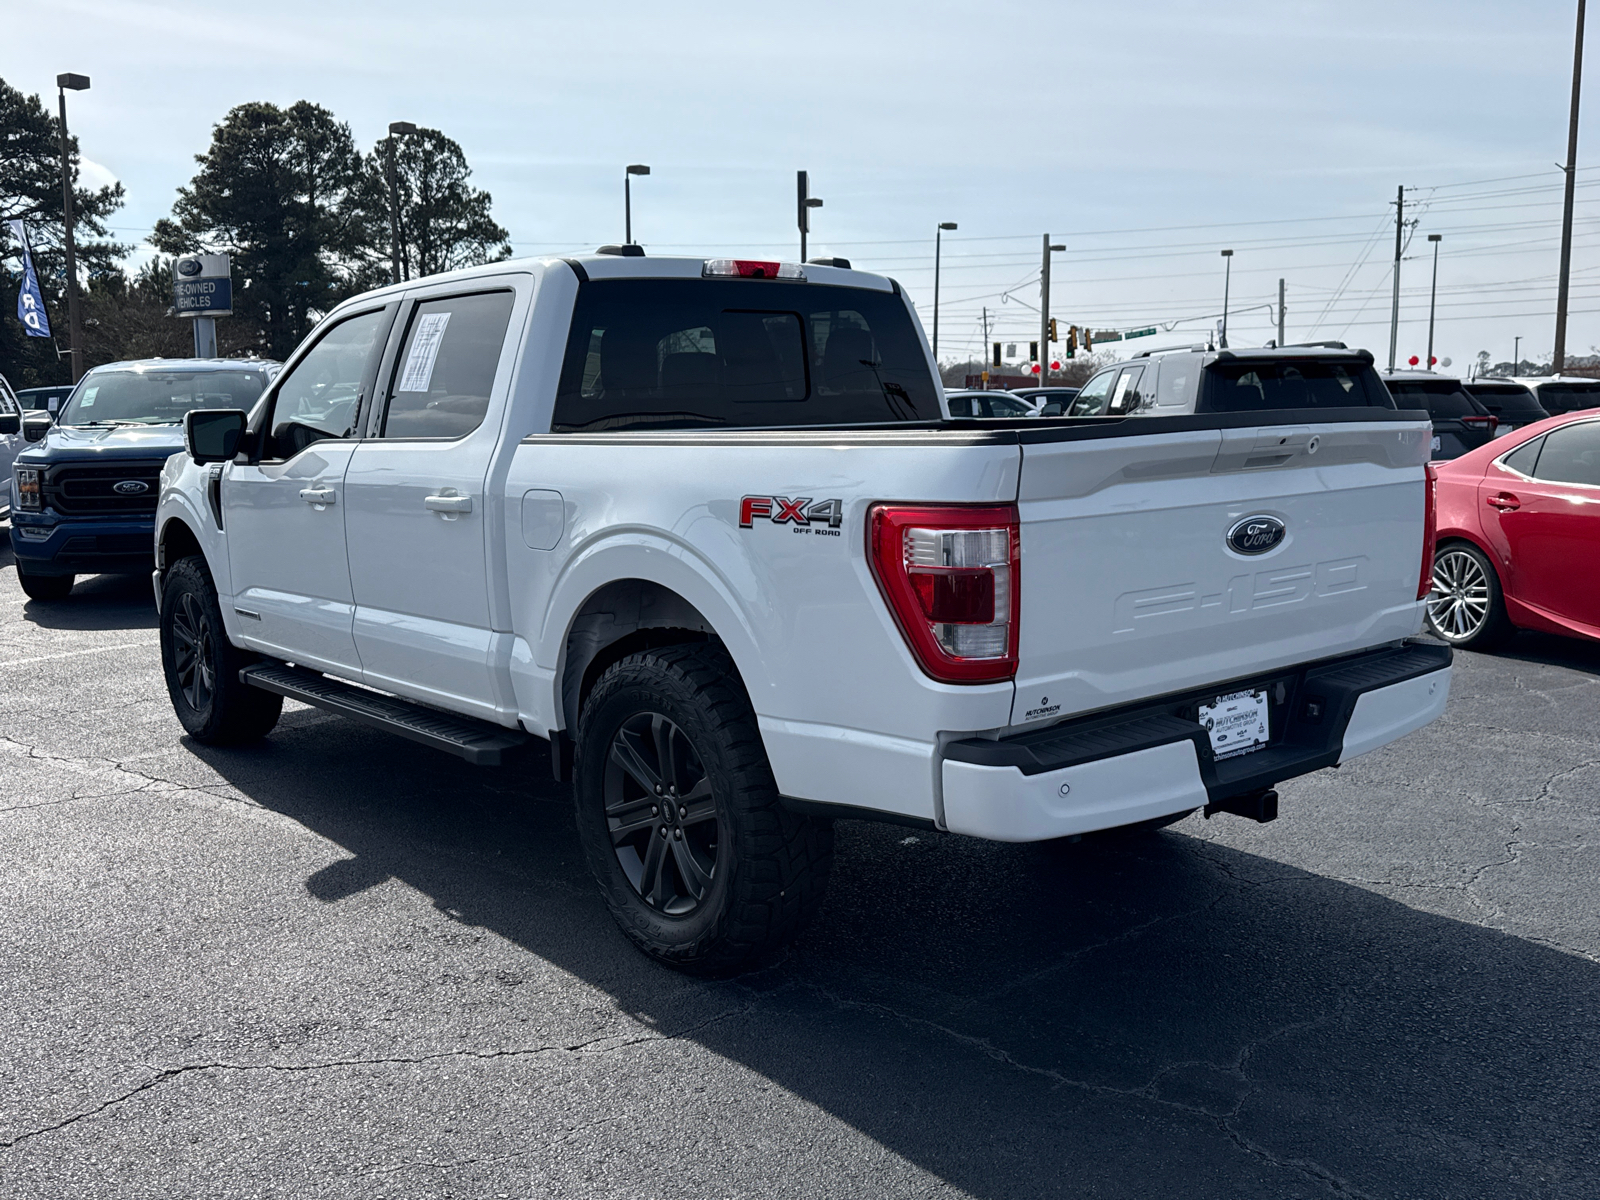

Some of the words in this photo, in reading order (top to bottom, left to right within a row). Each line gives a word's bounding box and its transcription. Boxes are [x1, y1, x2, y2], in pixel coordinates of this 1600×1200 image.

[176, 296, 211, 309] VEHICLES
[121, 482, 142, 492] Ford
[739, 494, 843, 530] FX4
[814, 529, 841, 537] ROAD
[1243, 523, 1276, 547] Ford
[1112, 554, 1370, 634] F-150
[1025, 704, 1061, 716] HUTCHINSON
[1216, 711, 1258, 728] HUTCHINSON
[1216, 722, 1243, 733] AUTOMOTIVE
[1243, 718, 1257, 727] GROUP
